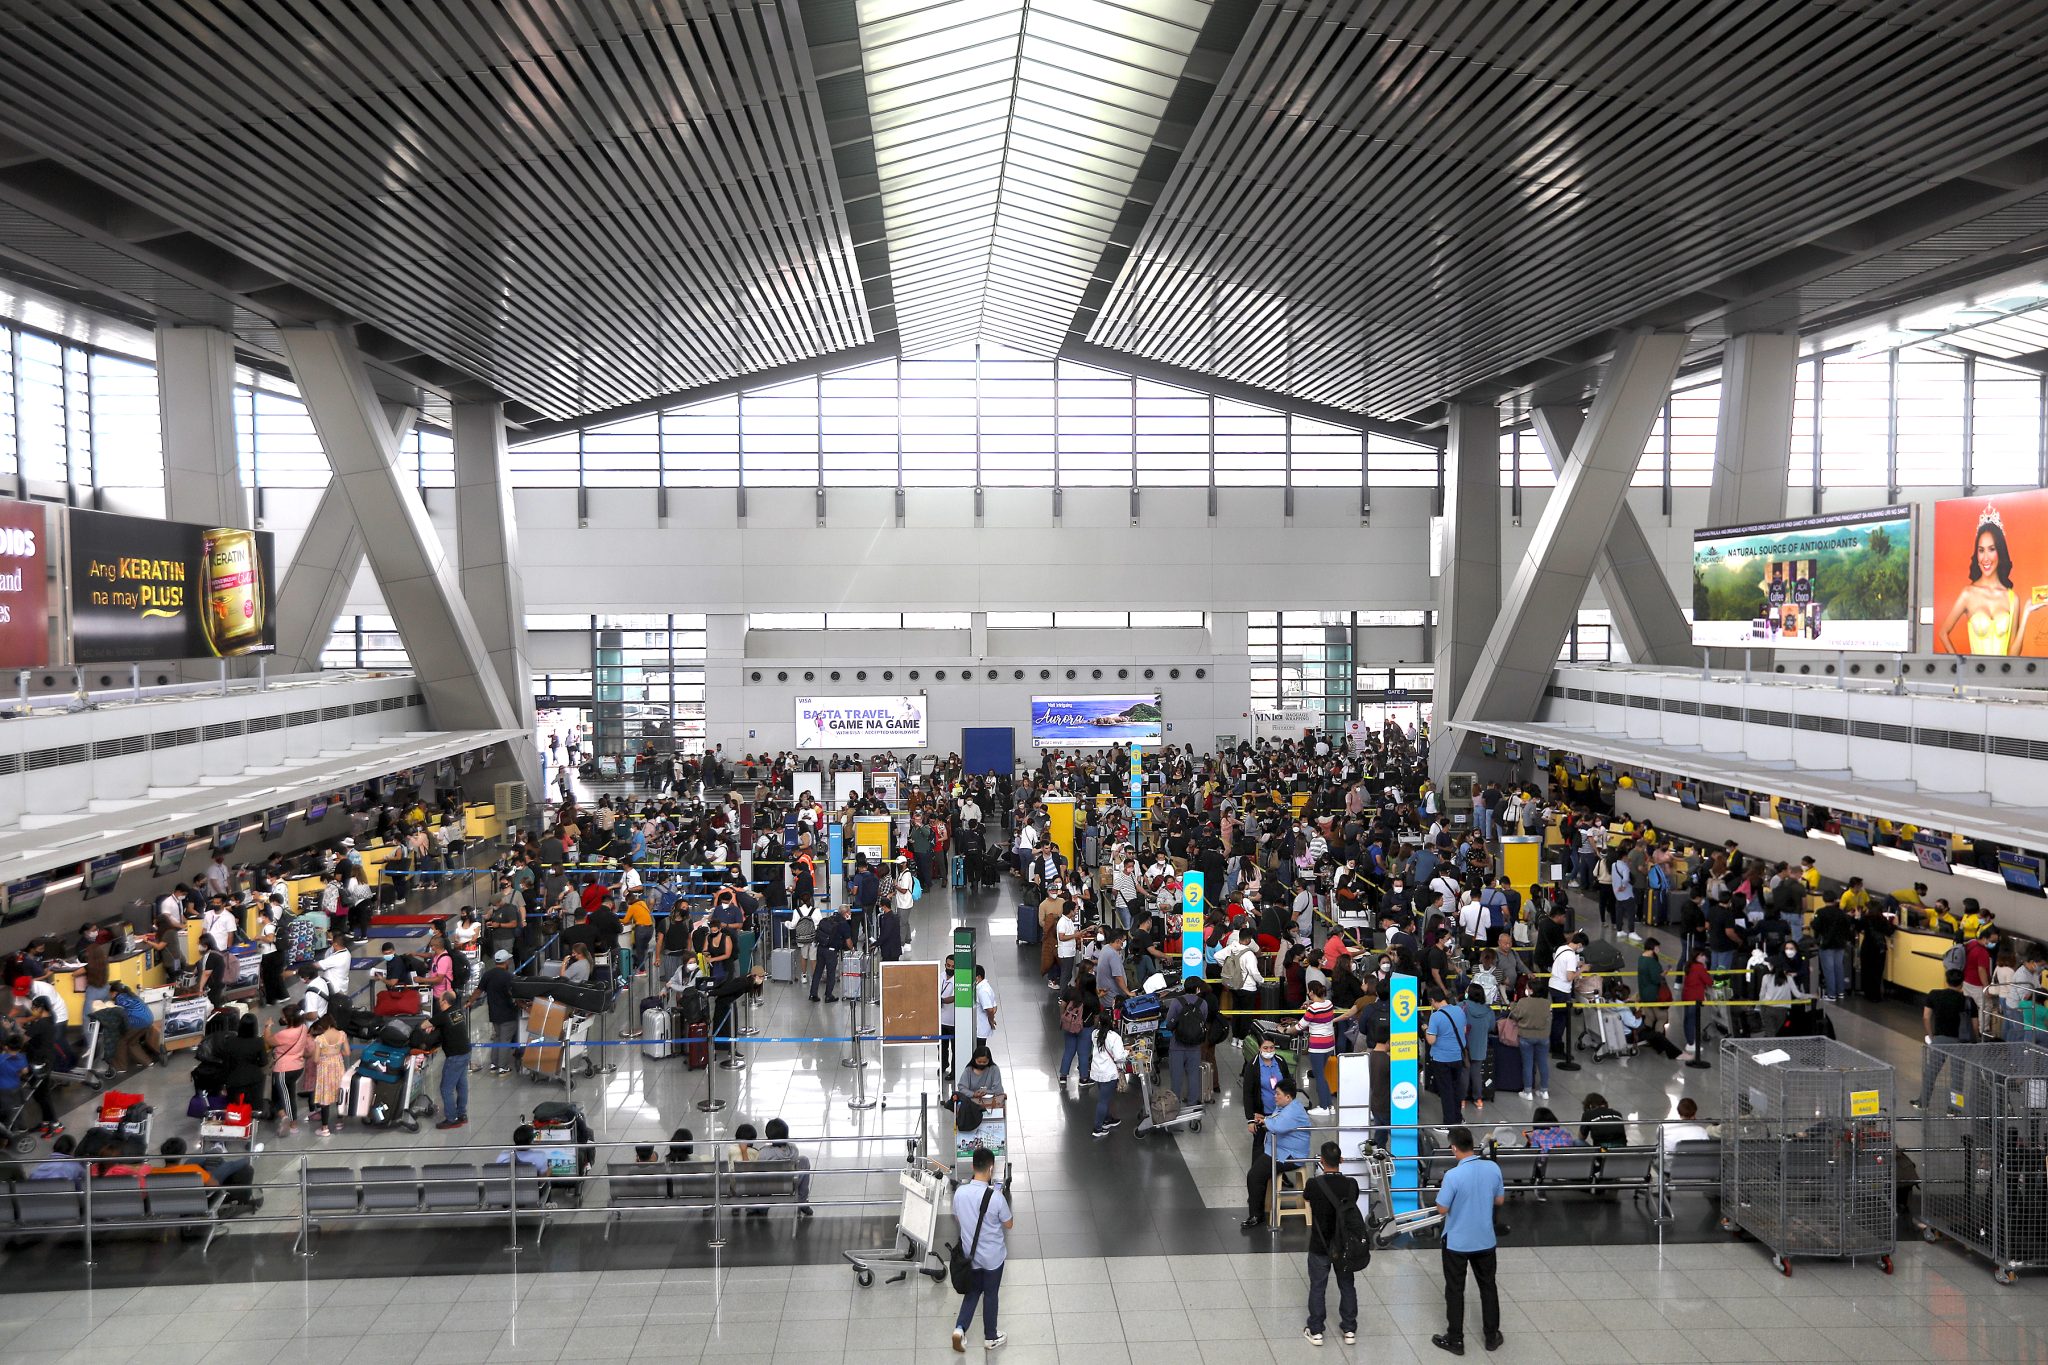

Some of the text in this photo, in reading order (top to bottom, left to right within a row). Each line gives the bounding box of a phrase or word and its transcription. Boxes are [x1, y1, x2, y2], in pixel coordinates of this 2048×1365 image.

[1728, 538, 1858, 556] NATURAL SOURCE OF ANTIOXIDANTS
[212, 549, 245, 567] KERATIN
[90, 557, 185, 582] Ang KERATIN
[93, 586, 184, 610] na may PLUS!
[1770, 592, 1784, 602] Coffee
[1795, 592, 1809, 602] Choco
[803, 710, 895, 720] BASTA TRAVEL,
[1036, 708, 1084, 725] Aurora
[829, 720, 920, 729] GAME NA GAME
[1190, 892, 1198, 902] 2
[1400, 1001, 1410, 1016] 3
